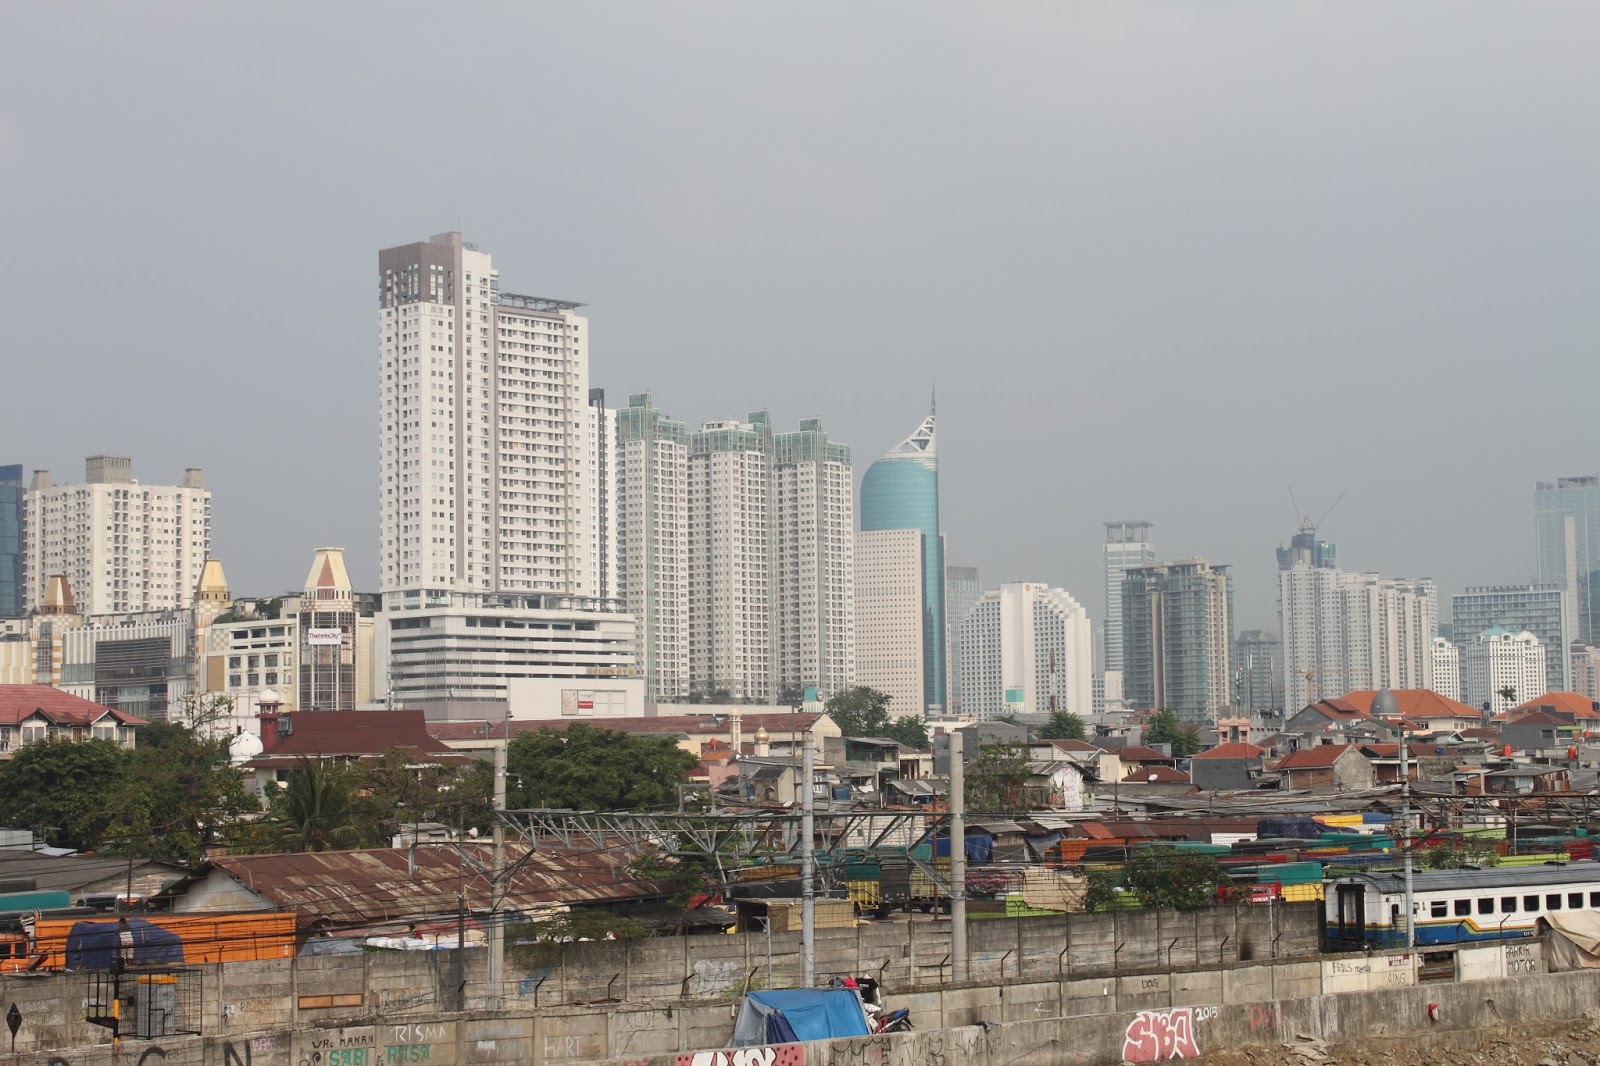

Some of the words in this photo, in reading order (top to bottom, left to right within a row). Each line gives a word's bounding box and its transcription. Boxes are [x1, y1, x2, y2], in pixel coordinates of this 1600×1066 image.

[1505, 944, 1531, 958] PARKIR
[1507, 959, 1536, 973] MOTOR
[1195, 1006, 1218, 1021] 2015
